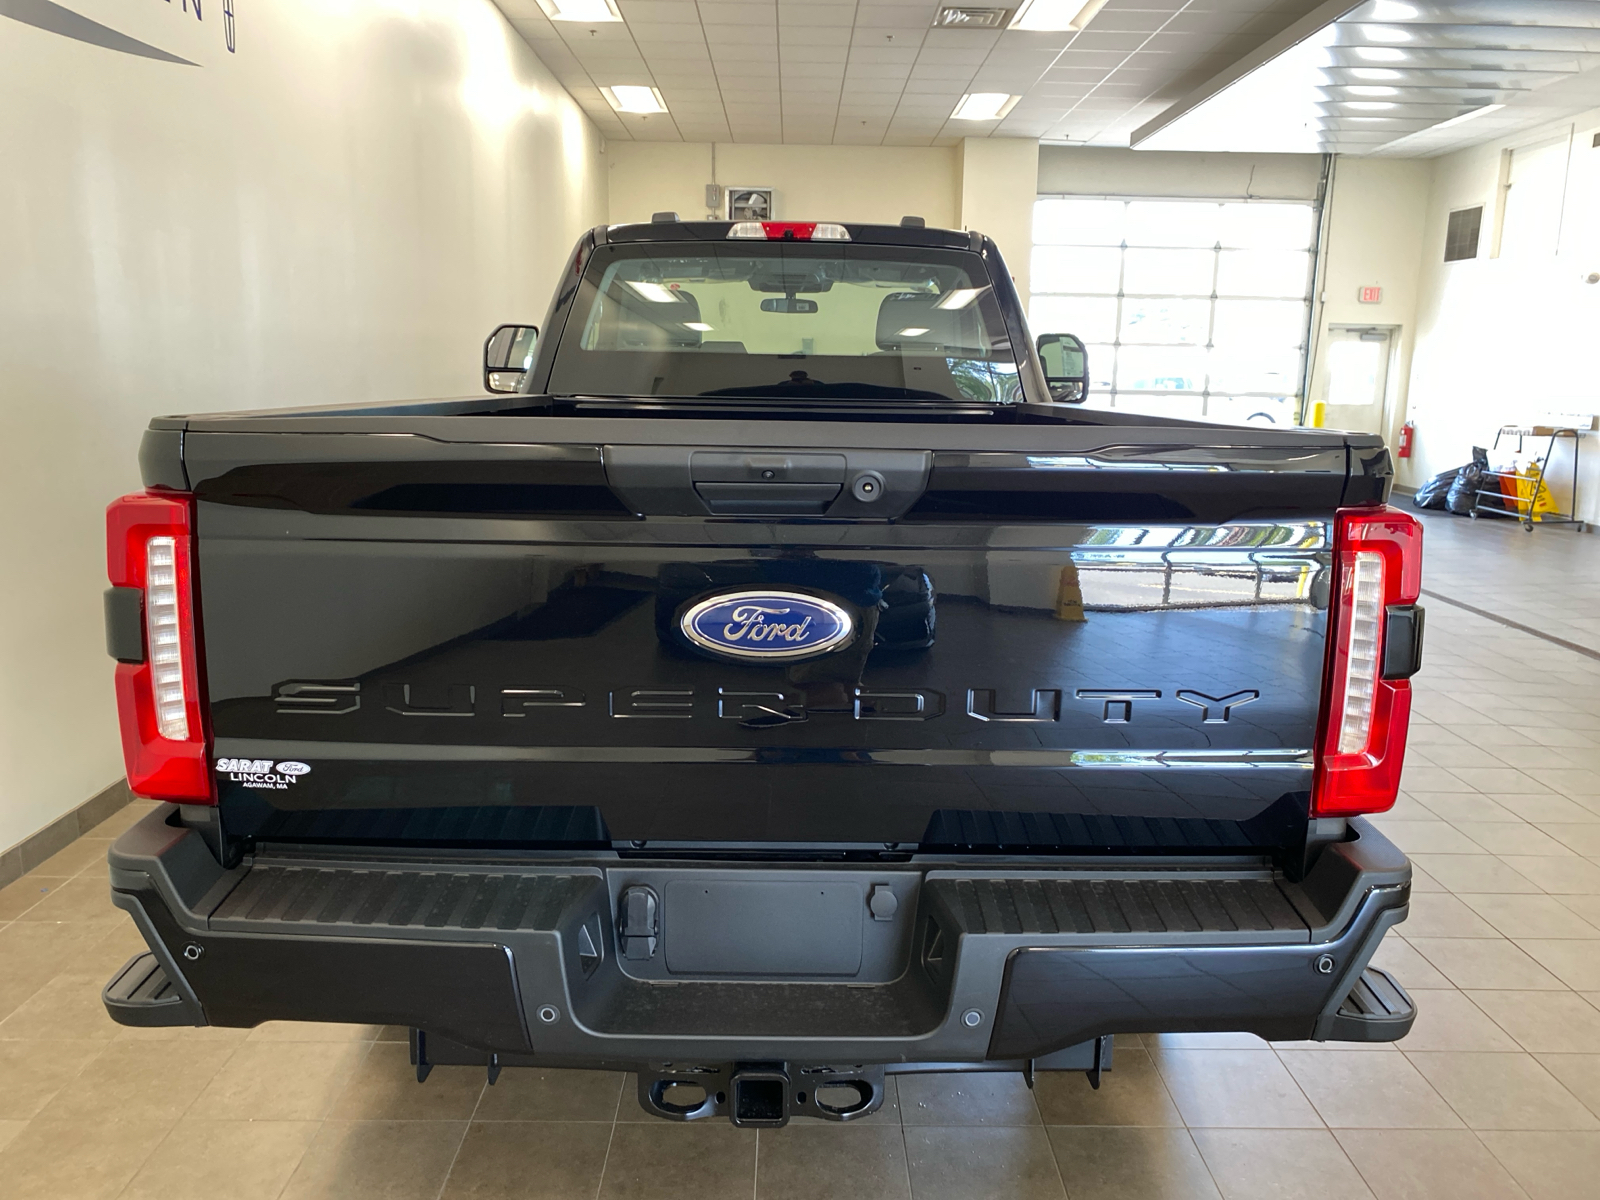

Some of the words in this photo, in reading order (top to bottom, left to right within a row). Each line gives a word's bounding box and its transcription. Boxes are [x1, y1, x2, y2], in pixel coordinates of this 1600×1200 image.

[1363, 286, 1381, 301] EXIT
[723, 605, 811, 642] Ford
[272, 680, 808, 722] SUPER
[854, 687, 1260, 724] DUTY
[216, 758, 274, 773] SARAT
[230, 772, 296, 783] LINCOLN
